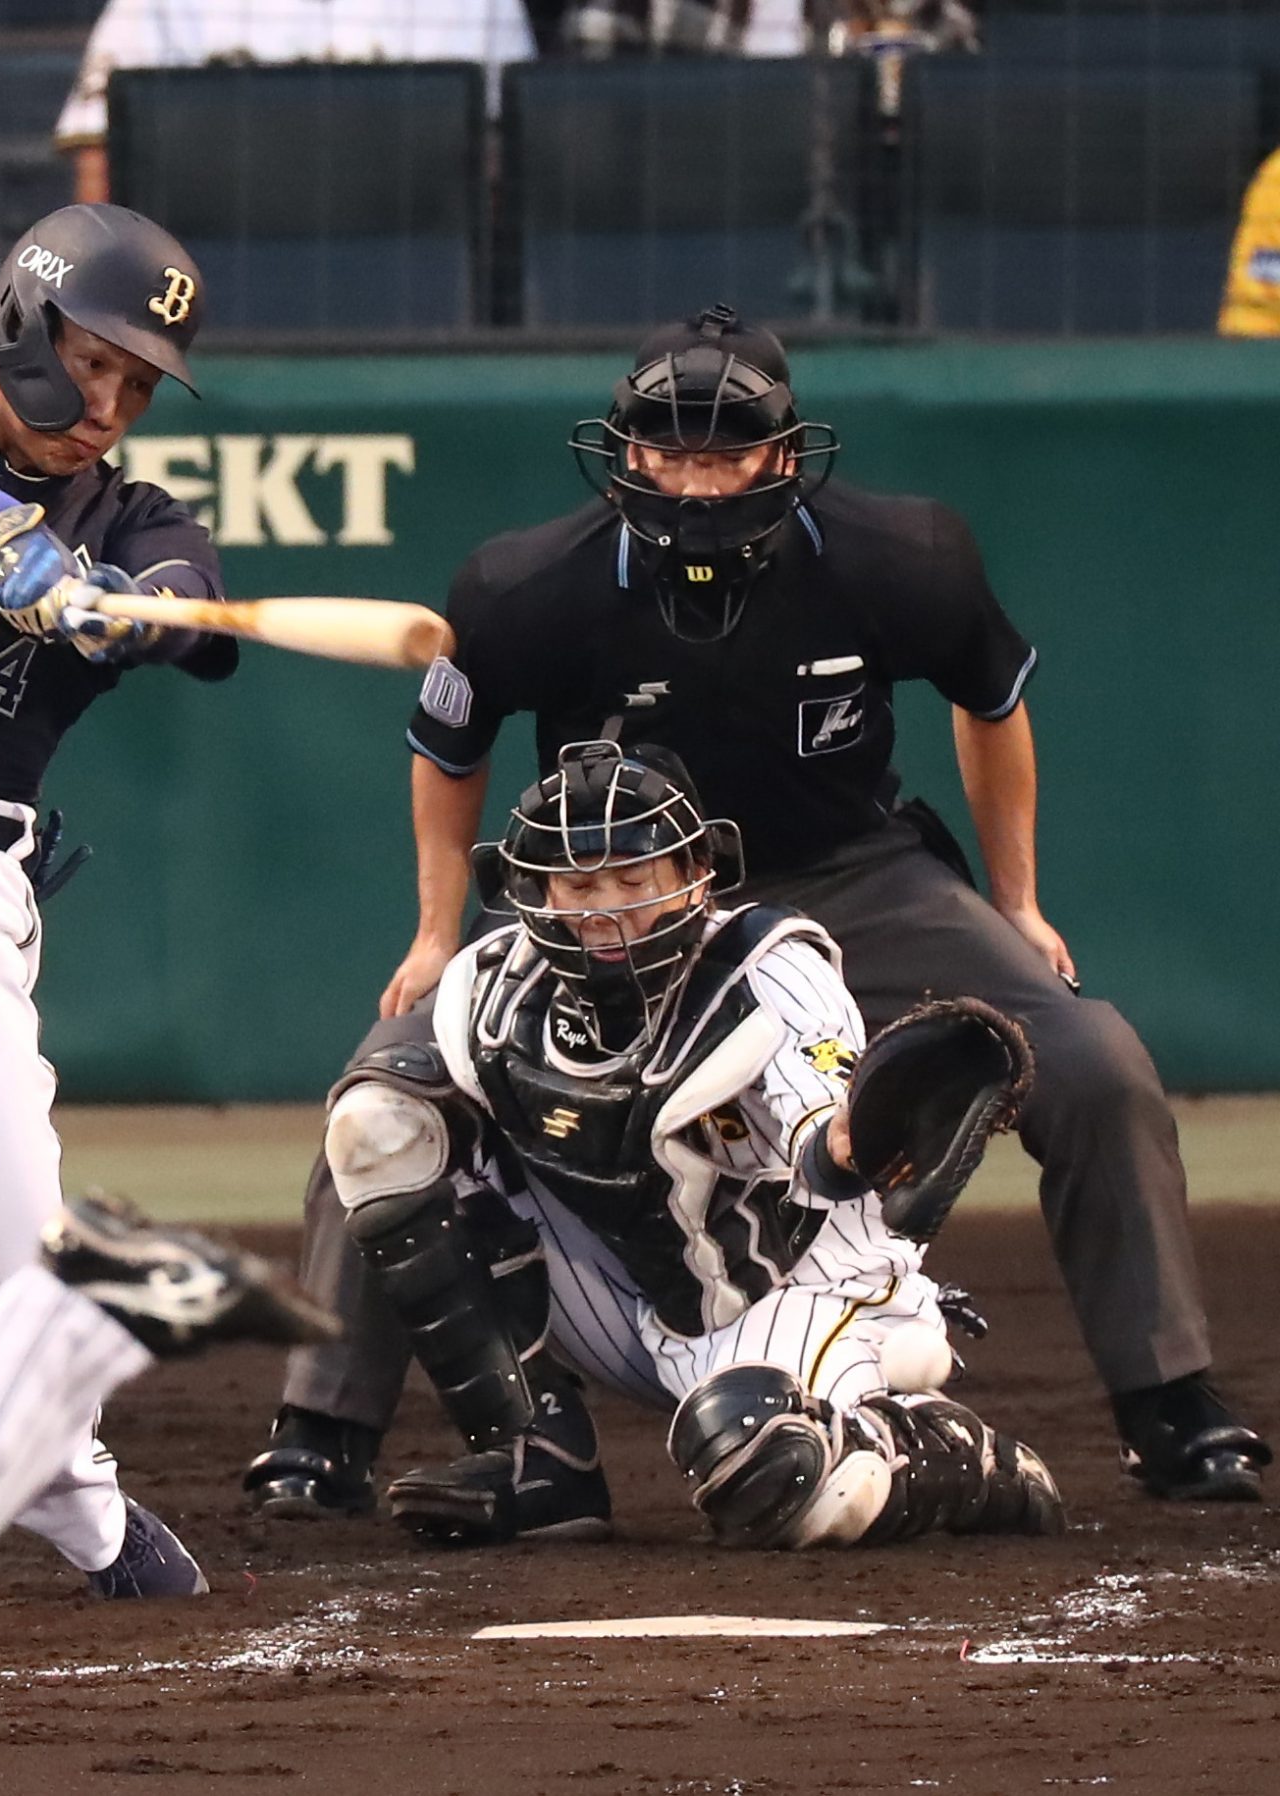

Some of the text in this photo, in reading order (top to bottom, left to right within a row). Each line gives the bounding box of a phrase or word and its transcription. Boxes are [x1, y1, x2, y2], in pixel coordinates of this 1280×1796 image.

[17, 244, 74, 289] ORIX
[148, 267, 196, 326] B
[104, 433, 416, 547] EKT
[556, 1017, 588, 1049] Ryu
[540, 1392, 562, 1415] 2
